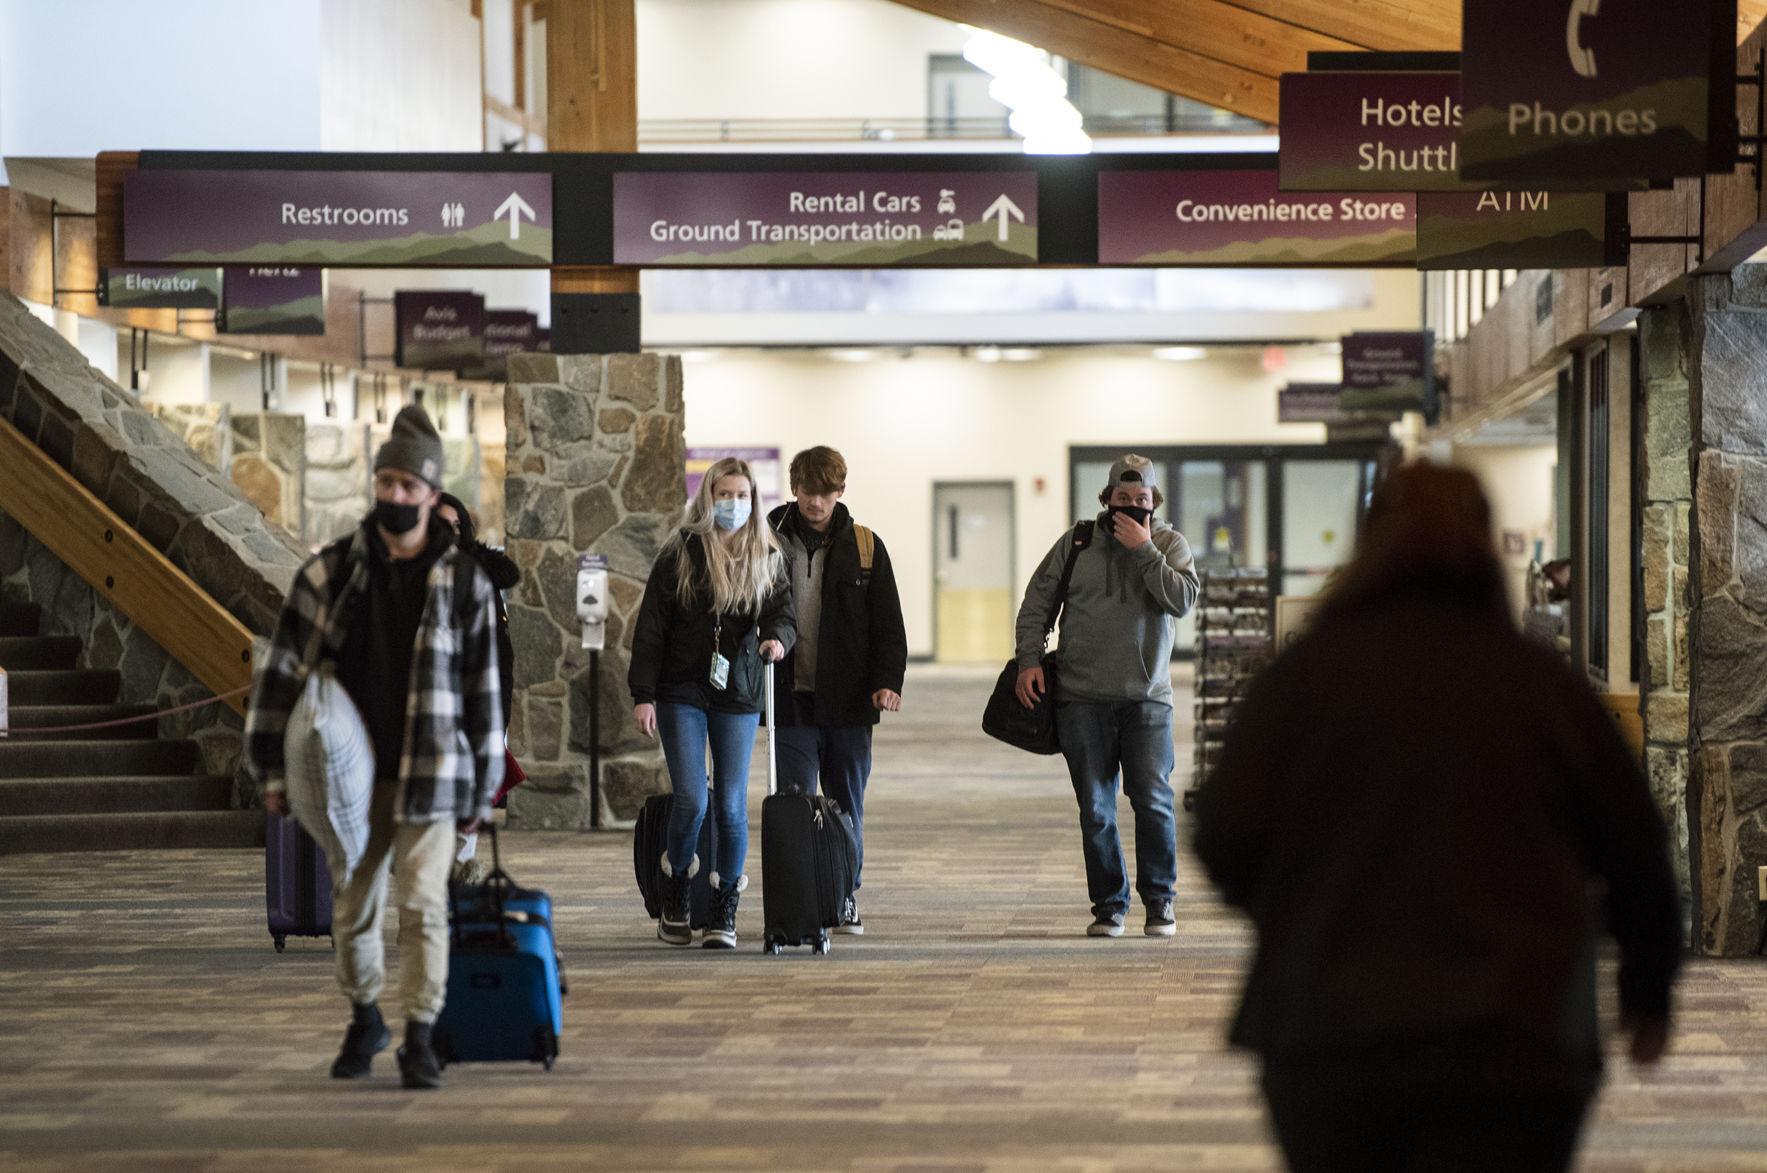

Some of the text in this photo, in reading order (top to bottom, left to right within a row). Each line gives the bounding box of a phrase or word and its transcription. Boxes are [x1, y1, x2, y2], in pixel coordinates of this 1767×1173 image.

[1360, 96, 1462, 127] Hotels
[1508, 102, 1657, 136] Phones
[1357, 141, 1457, 172] Shuttl
[281, 202, 409, 226] Restrooms
[789, 190, 921, 213] Rental Cars
[1176, 198, 1405, 222] Convenience Store
[650, 219, 921, 246] Ground Transportation
[125, 273, 199, 292] Elevator
